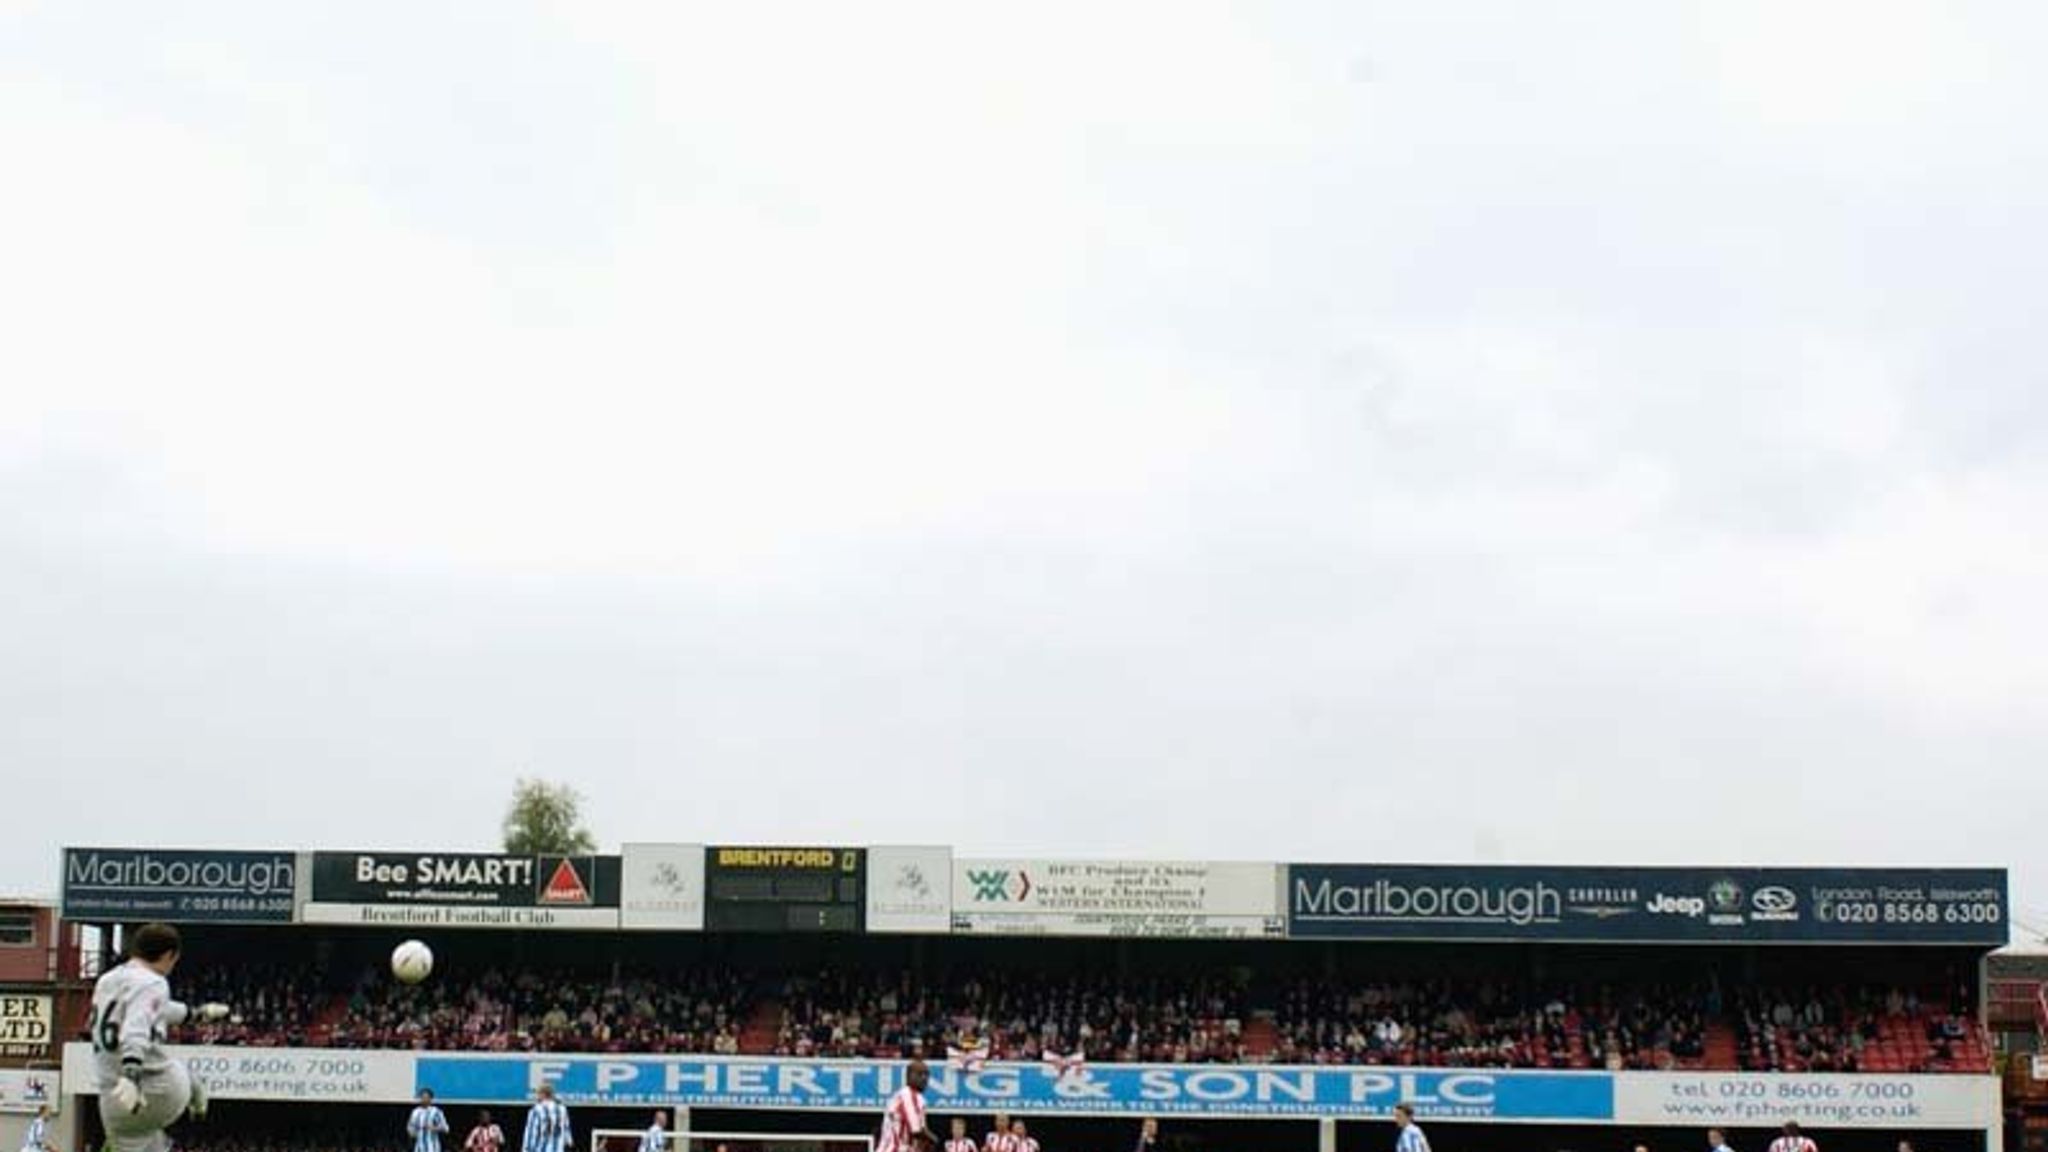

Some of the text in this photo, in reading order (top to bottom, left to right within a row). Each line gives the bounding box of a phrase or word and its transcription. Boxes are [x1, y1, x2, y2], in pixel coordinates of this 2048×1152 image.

[719, 850, 834, 868] BRENTFORD
[68, 852, 293, 894] Marlborough
[356, 856, 533, 884] Bee SMART!
[1295, 878, 1561, 925] Marlborough
[1568, 887, 1639, 903] CHRYSLER
[1811, 886, 1872, 901] London
[1646, 892, 1705, 917] Jeep
[1837, 903, 2000, 922] 020 8568 6300
[363, 907, 556, 925] Brentford Football Club
[187, 1057, 364, 1076] 020 8606 7000
[529, 1062, 570, 1091] F
[596, 1063, 640, 1091] P
[665, 1062, 1021, 1097] HERTING
[1140, 1070, 1315, 1101] SON
[1350, 1071, 1495, 1103] PLC
[1671, 1082, 1914, 1100] tel 020 8606 7000
[934, 1098, 981, 1109] AND
[1163, 1101, 1203, 1112] THE
[1208, 1102, 1380, 1114] CONSTRUCTION
[1664, 1100, 1921, 1122] www.fpherting.co.uk
